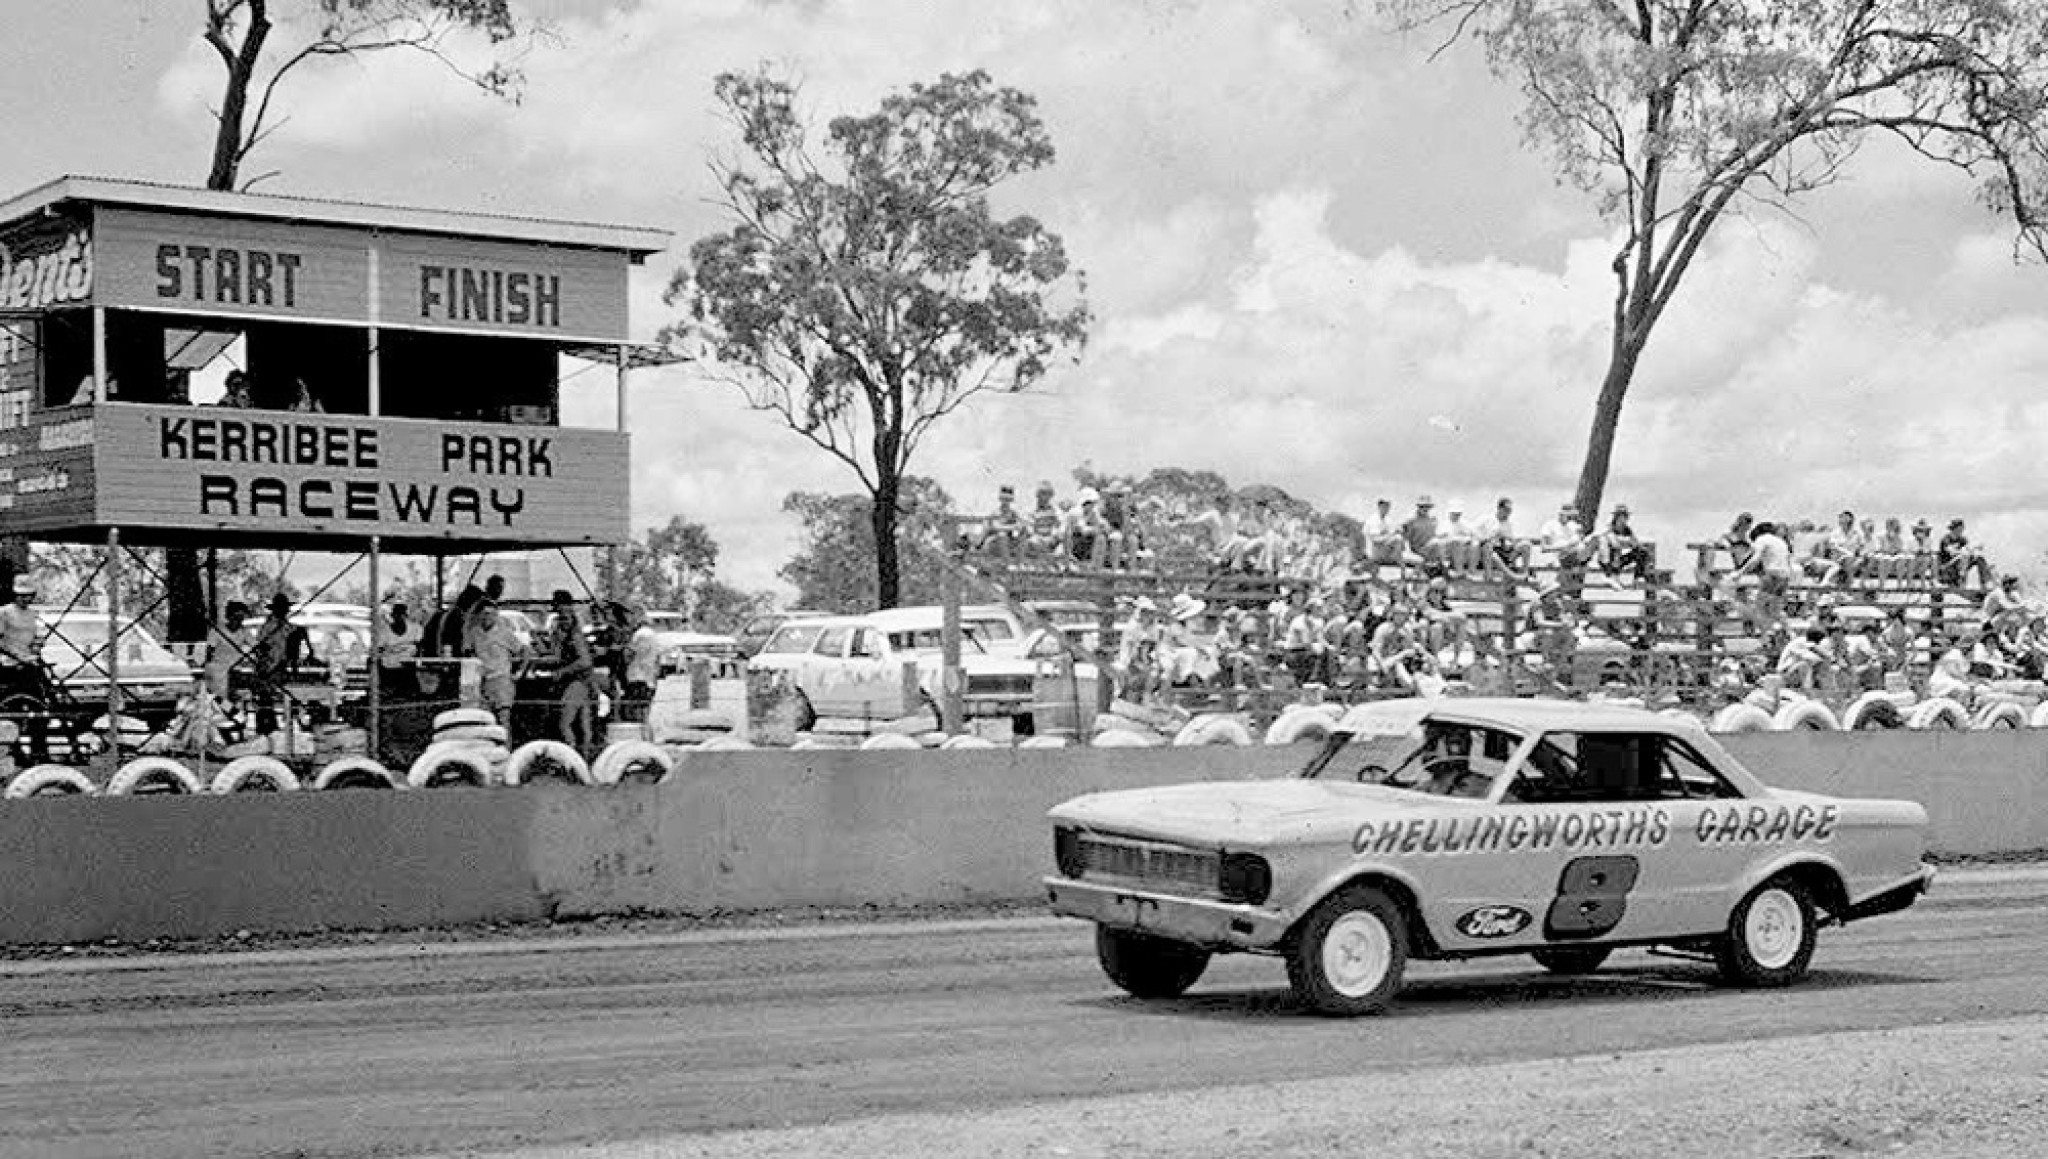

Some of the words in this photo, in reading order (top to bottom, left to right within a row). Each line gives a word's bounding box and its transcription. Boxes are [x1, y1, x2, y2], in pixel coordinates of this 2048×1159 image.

[157, 245, 300, 306] START
[419, 266, 560, 326] FINISH
[160, 417, 379, 468] KERRIBEE
[442, 434, 553, 477] PARK
[200, 475, 525, 526] RACEWAY
[1697, 804, 1838, 844] GARAGE
[1466, 908, 1524, 938] Ford
[1543, 855, 1638, 940] 8
